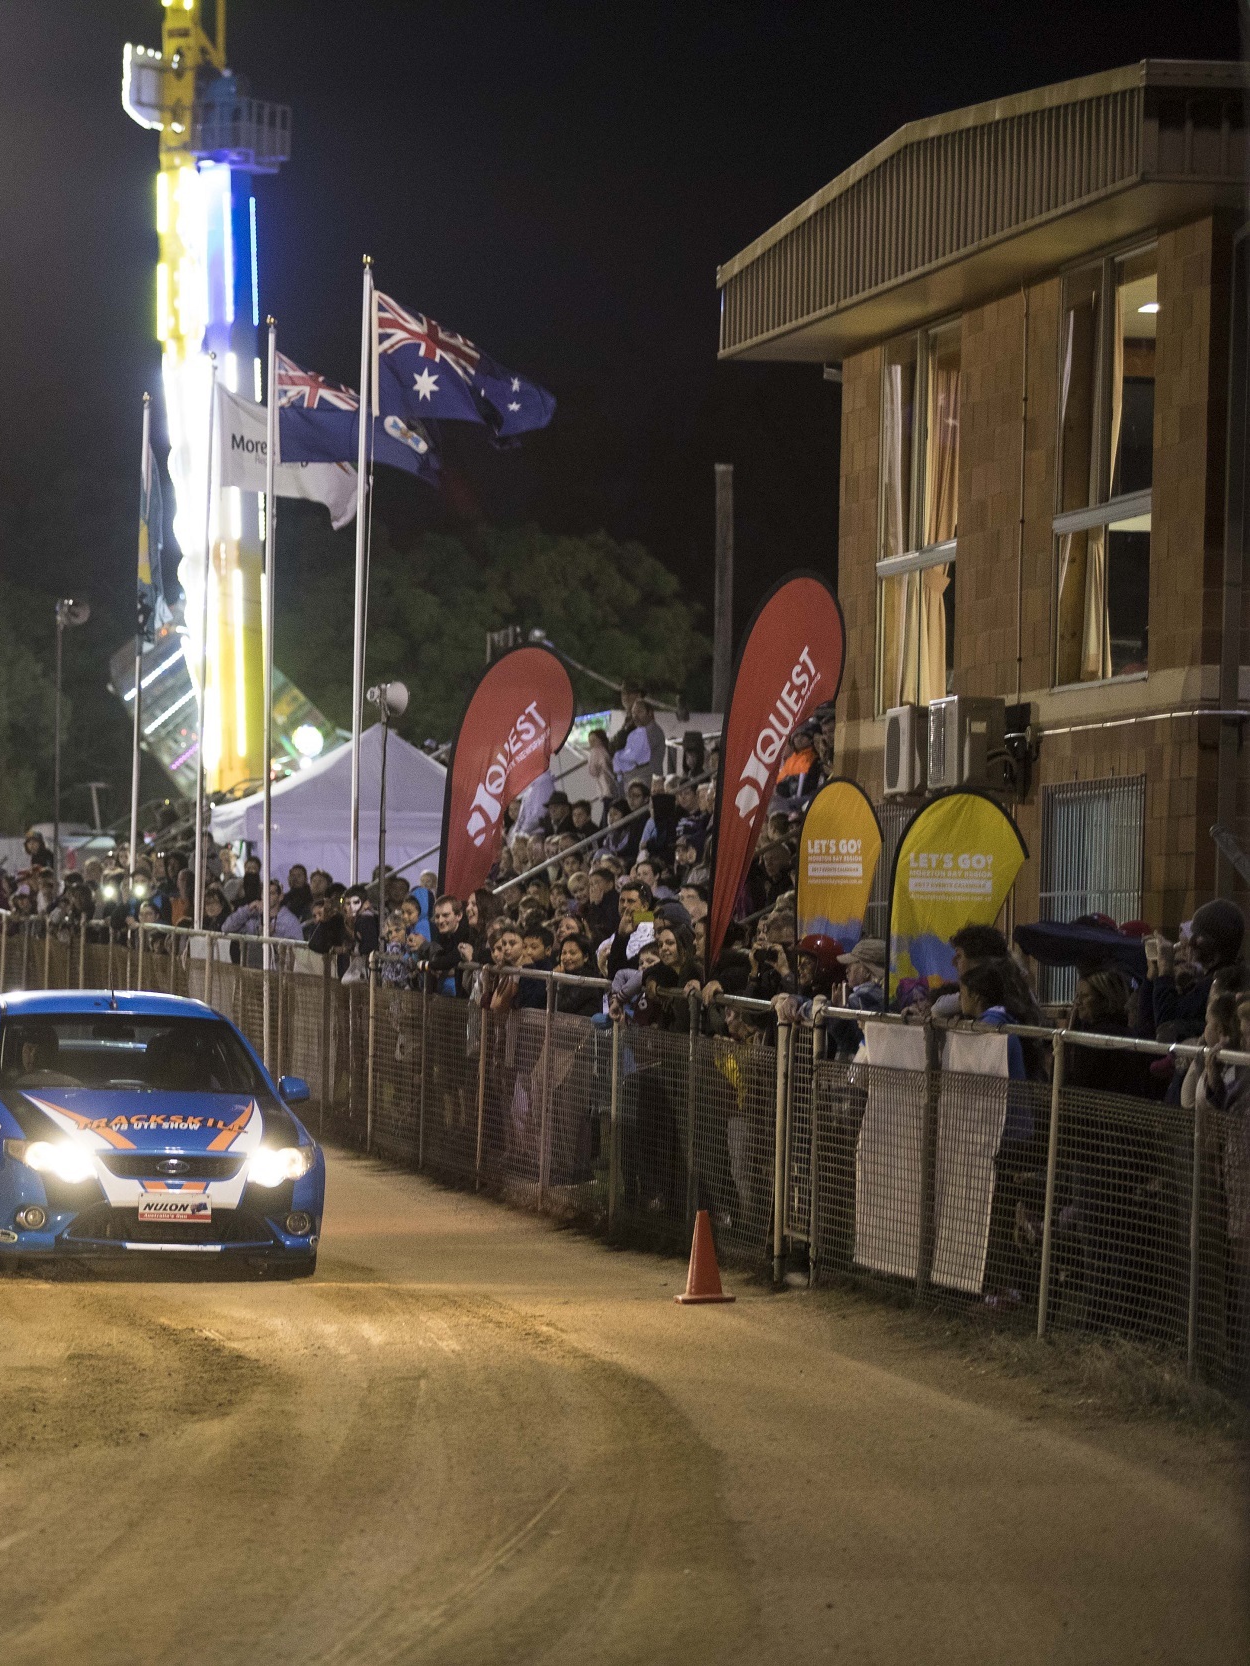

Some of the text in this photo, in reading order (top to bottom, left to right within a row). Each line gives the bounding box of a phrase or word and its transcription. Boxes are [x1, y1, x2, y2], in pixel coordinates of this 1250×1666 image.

[231, 433, 267, 455] More
[756, 644, 816, 765] QUEST
[485, 700, 546, 795] QUEST
[807, 838, 836, 855] LET'S
[909, 852, 954, 869] LET'S
[75, 1114, 249, 1134] TRACKSKILL
[112, 1121, 200, 1132] V8 UTE SHOW
[143, 1202, 190, 1212] NULON
